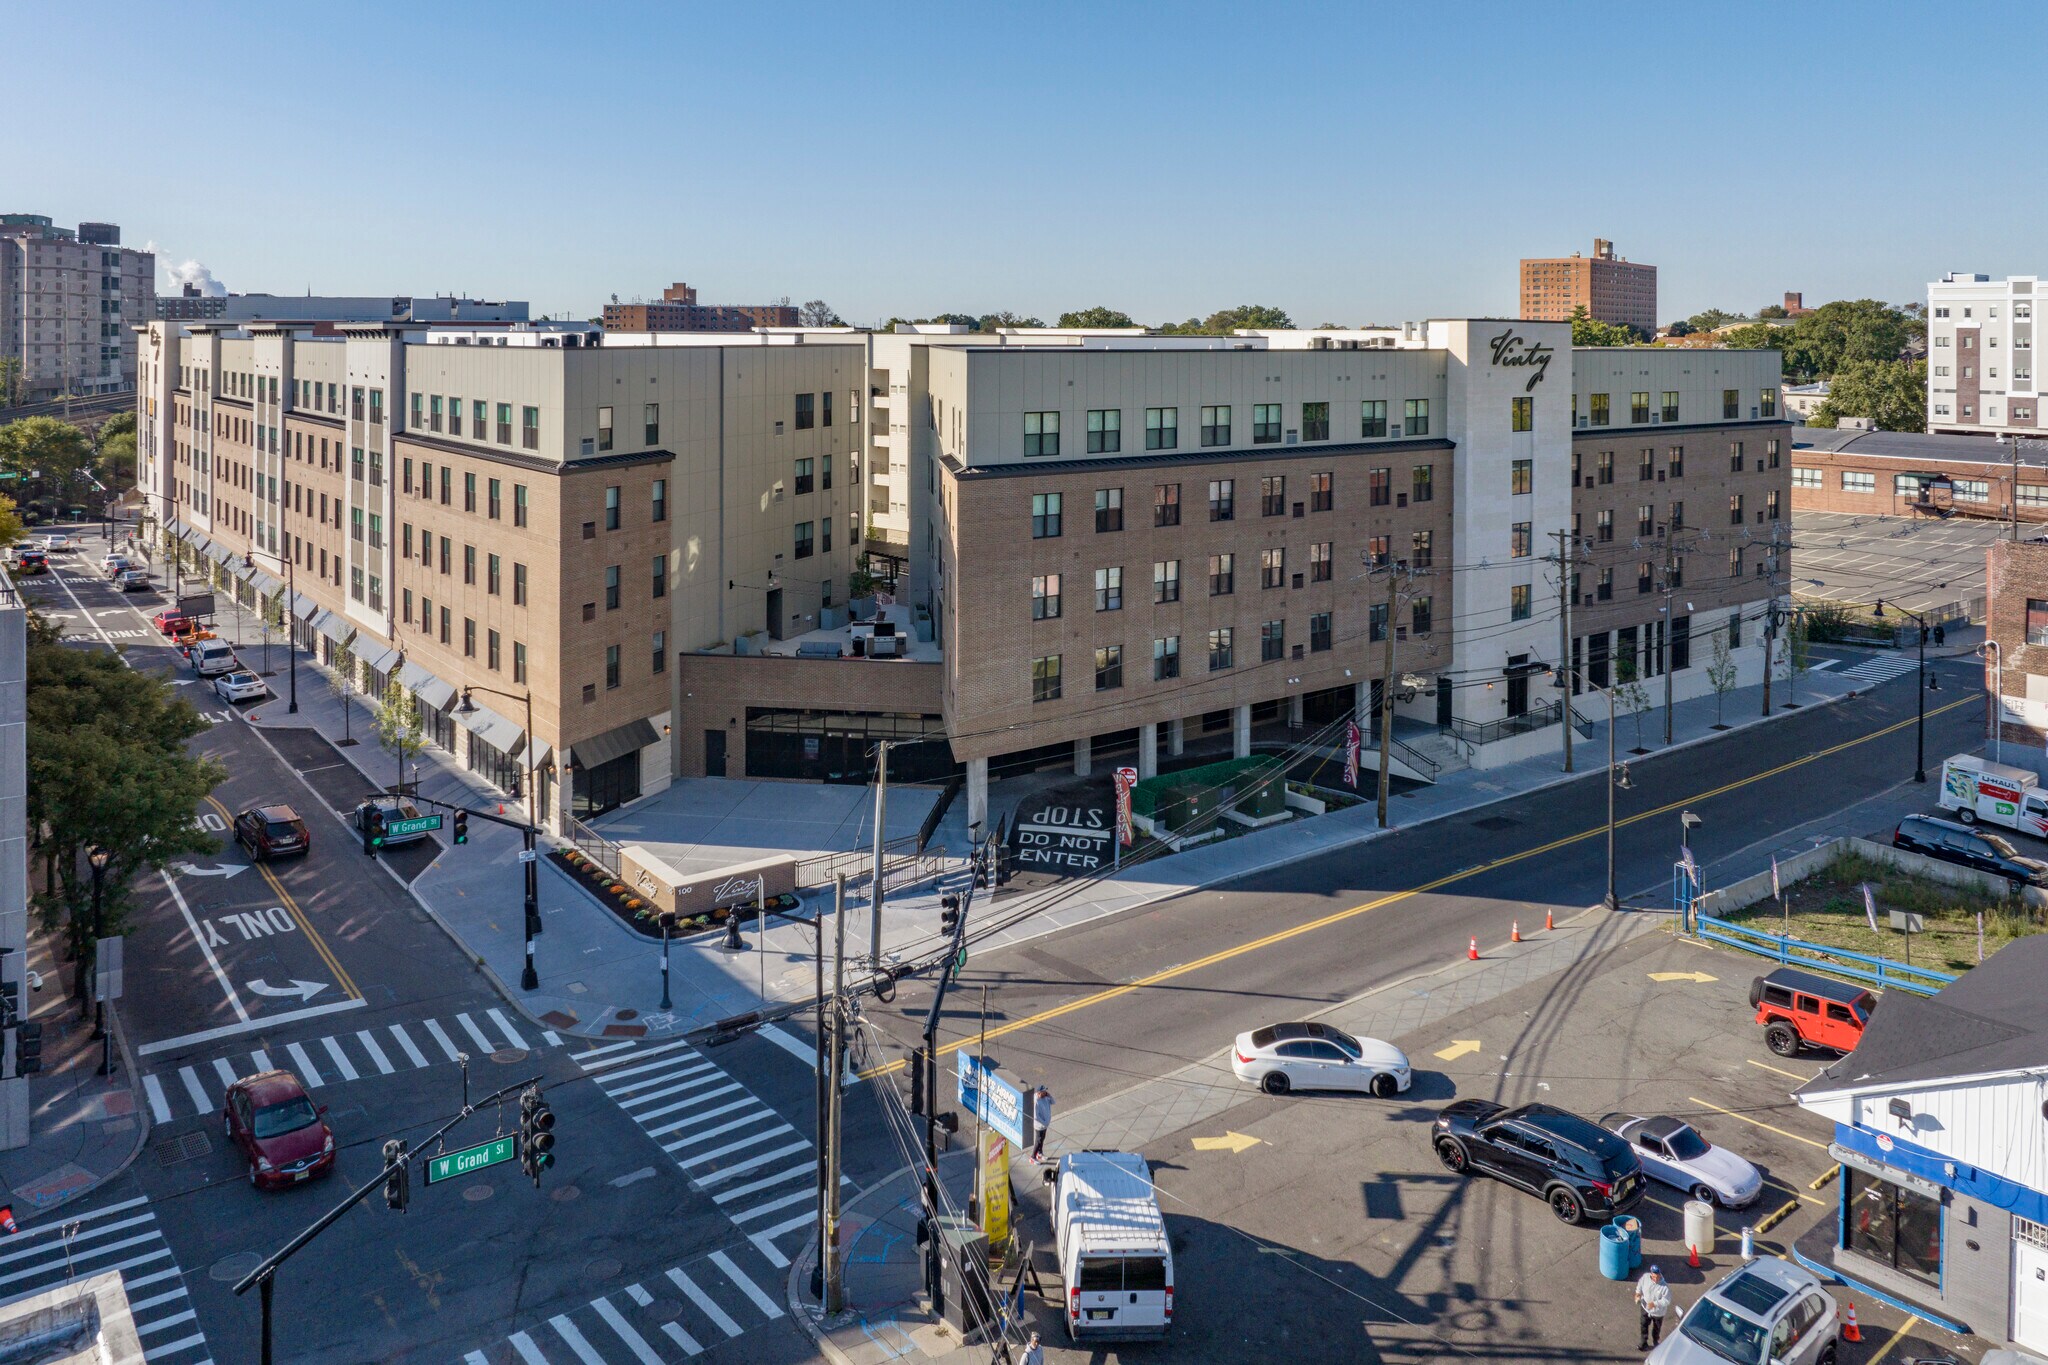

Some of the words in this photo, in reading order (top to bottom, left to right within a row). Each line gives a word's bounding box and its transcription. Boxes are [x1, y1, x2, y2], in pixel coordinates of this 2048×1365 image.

[1490, 327, 1555, 393] Vinty
[106, 628, 149, 639] ONLY
[1981, 775, 2017, 790] U-HAUL
[391, 824, 400, 834] W
[401, 819, 428, 832] Grand
[430, 817, 438, 826] St
[1032, 805, 1103, 828] STOP
[1018, 832, 1050, 846] DO
[1060, 835, 1108, 852] NOT
[1019, 848, 1099, 869] ENTER
[677, 886, 692, 896] 100
[202, 906, 297, 948] ONLY
[440, 1159, 450, 1176] W
[457, 1148, 489, 1171] Grand
[496, 1143, 504, 1155] St
